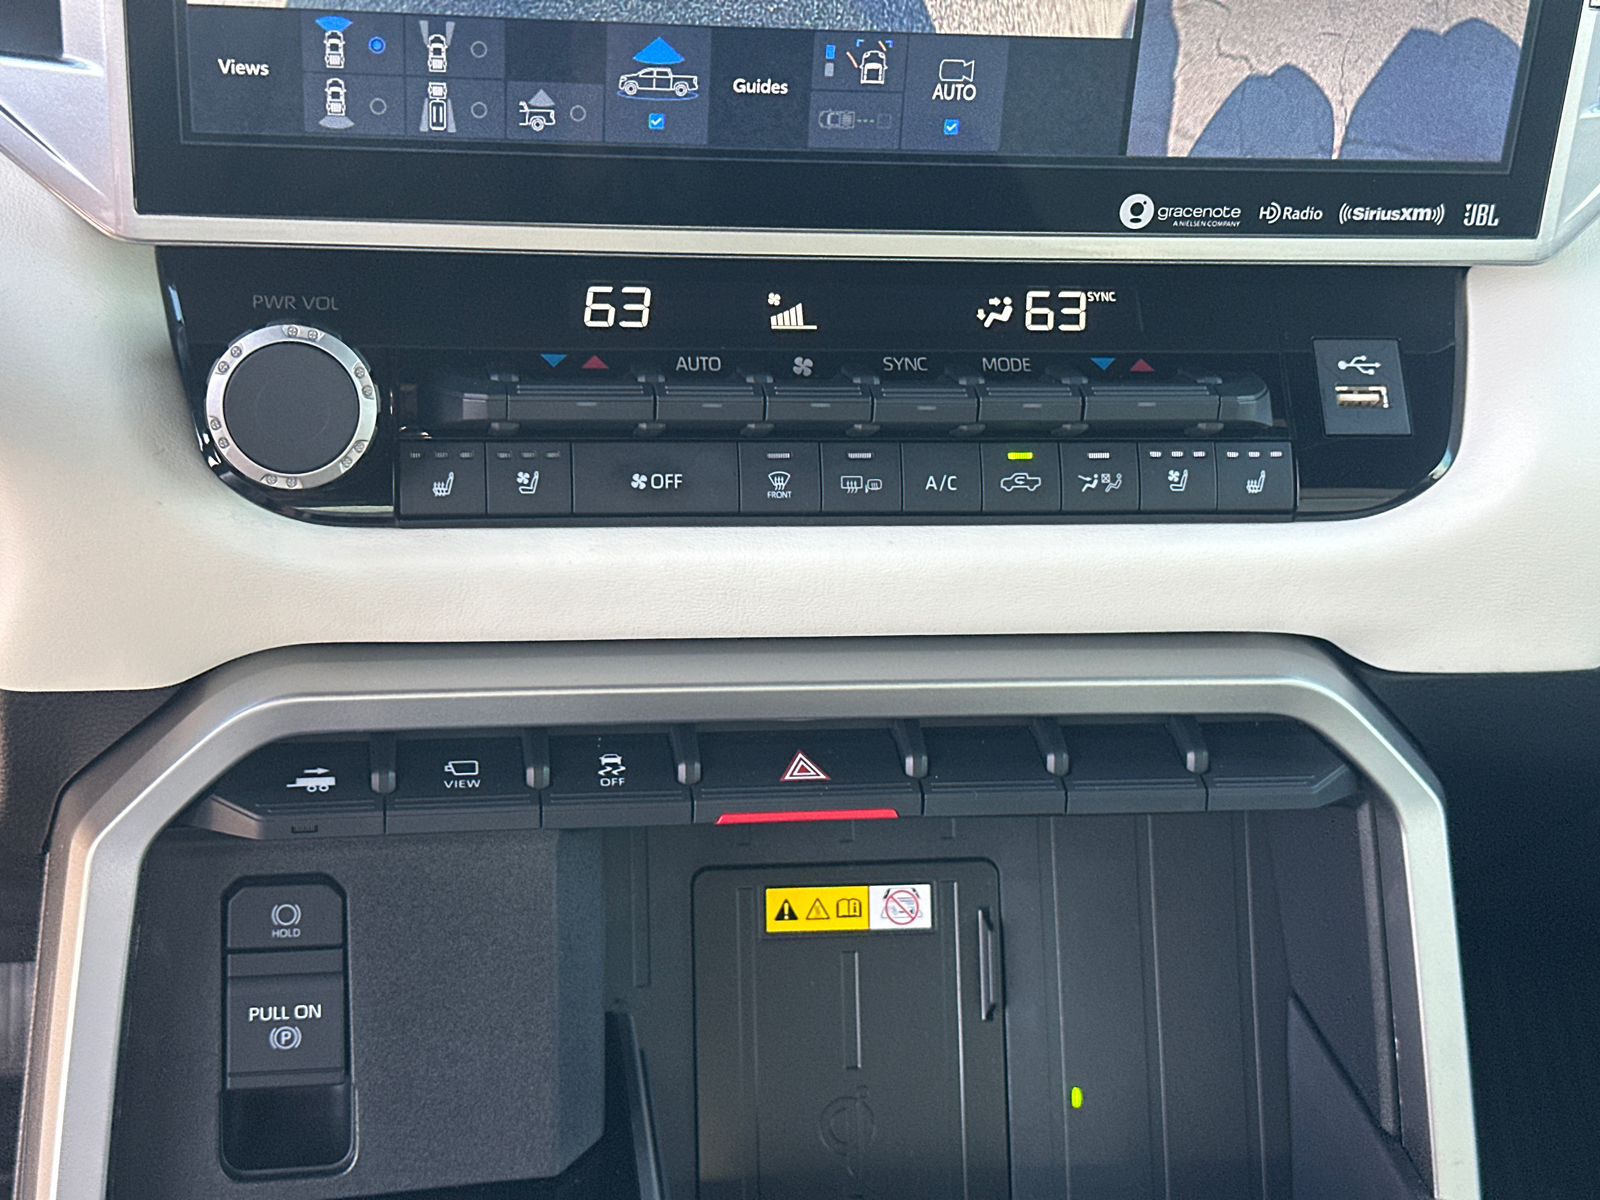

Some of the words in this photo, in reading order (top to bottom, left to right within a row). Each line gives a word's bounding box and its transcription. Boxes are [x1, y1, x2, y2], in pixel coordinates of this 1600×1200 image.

[217, 58, 270, 76] Views
[732, 77, 789, 96] Guides
[931, 83, 977, 102] AUTO
[1157, 205, 1242, 221] gracenote
[1283, 205, 1324, 221] Radio
[1464, 203, 1500, 227] JBL
[1172, 220, 1179, 228] A
[1178, 220, 1207, 228] NIELSEN
[1206, 220, 1241, 228] COMPANY
[252, 294, 297, 310] PWR
[302, 296, 339, 311] VOL
[582, 285, 652, 329] 63
[1024, 290, 1087, 332] 63
[1087, 291, 1117, 303] SYNC
[675, 356, 722, 372] AUTO
[882, 356, 928, 372] SYNC
[982, 357, 1032, 372] MODE
[650, 473, 683, 490] OFF
[925, 474, 958, 492] A/C
[766, 489, 792, 499] FRONT
[443, 779, 481, 789] VIEW
[599, 777, 625, 788] OFF
[271, 928, 301, 939] HOLD
[248, 1005, 290, 1022] PULL
[293, 1003, 322, 1021] ON
